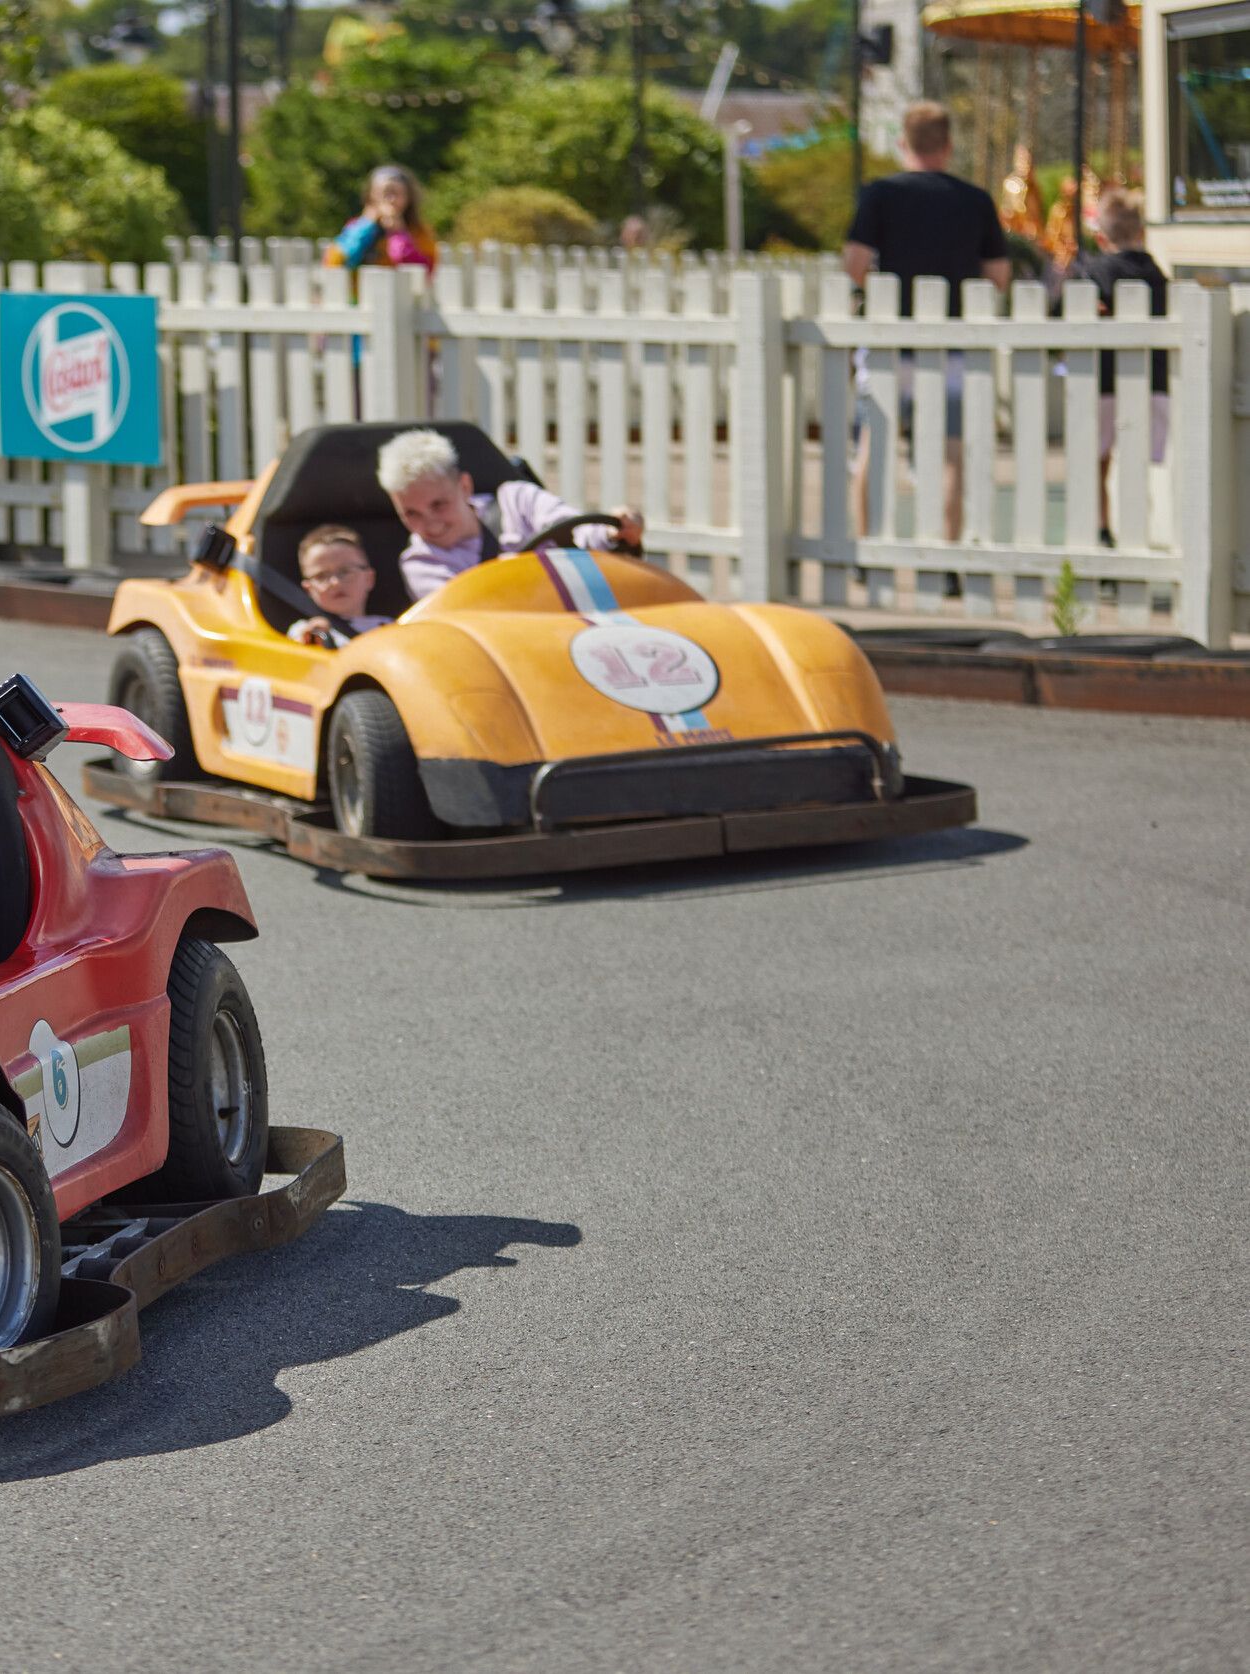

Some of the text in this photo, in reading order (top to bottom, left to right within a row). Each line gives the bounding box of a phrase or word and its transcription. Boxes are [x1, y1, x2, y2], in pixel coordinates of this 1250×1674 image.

[589, 641, 704, 690] 12
[245, 688, 267, 725] 12
[50, 1049, 70, 1110] 6
